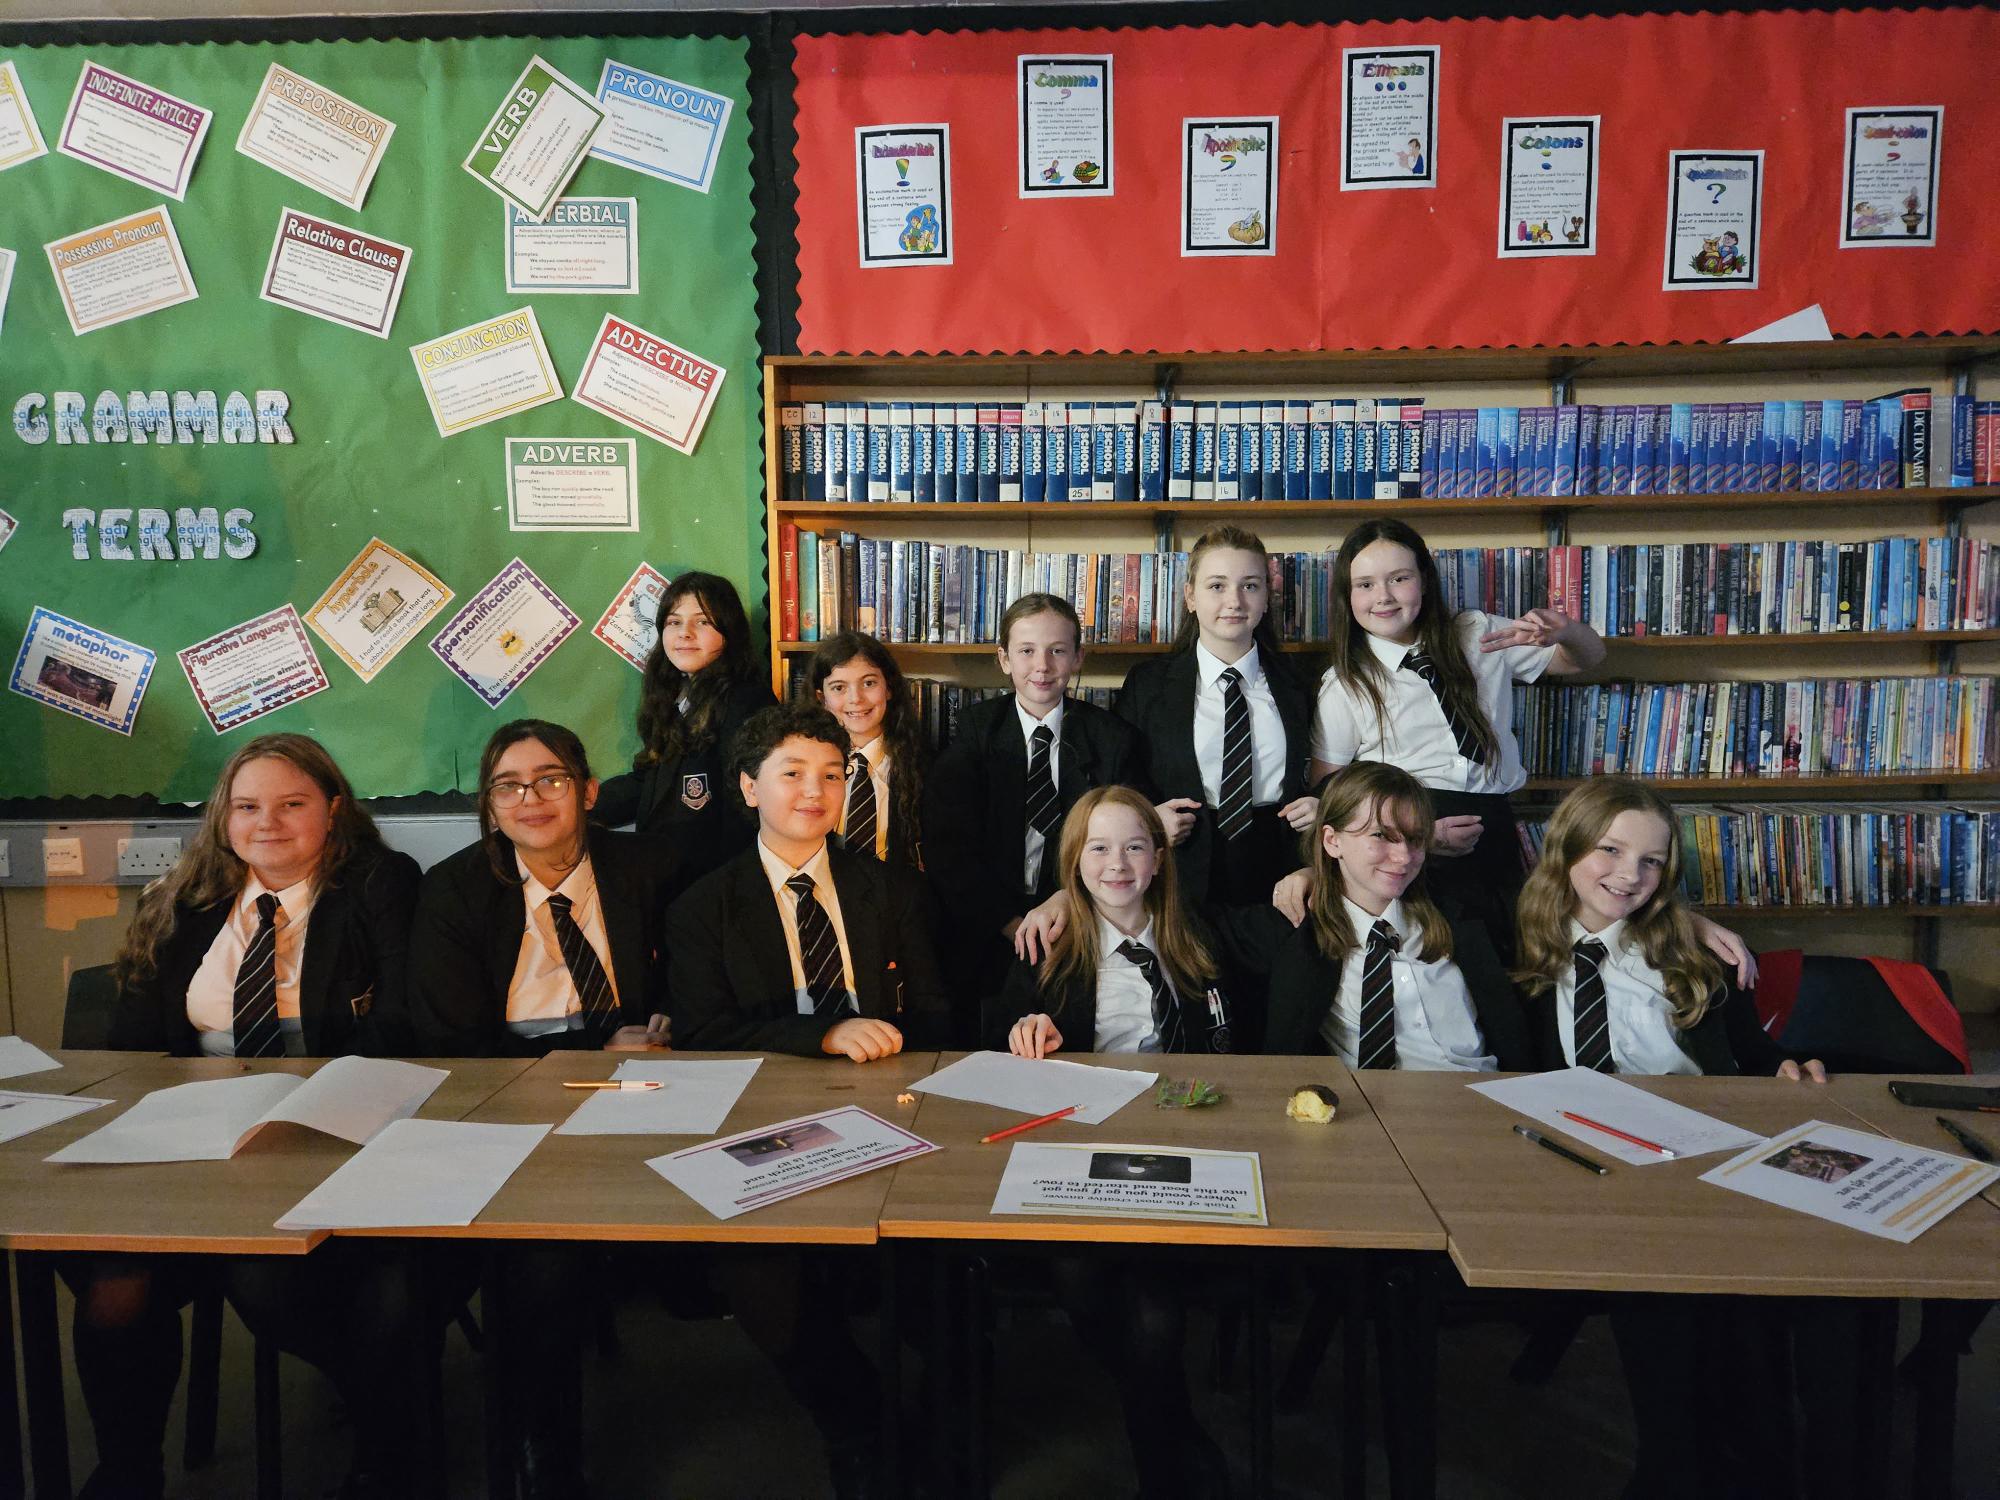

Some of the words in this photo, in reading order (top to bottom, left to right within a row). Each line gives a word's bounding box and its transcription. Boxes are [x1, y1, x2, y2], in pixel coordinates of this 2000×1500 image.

[86, 70, 153, 111] INDEFINITE
[149, 96, 199, 131] ARTICLE
[608, 67, 721, 120] PRONOUN
[1034, 72, 1098, 87] Comma
[270, 72, 382, 142] PREPOSITION
[484, 87, 538, 155] VERB
[1519, 134, 1583, 150] Colons
[514, 205, 625, 223] AERBIAL
[1705, 182, 1726, 204] ?
[54, 232, 114, 265] Possessive
[111, 215, 162, 246] Pronoun
[286, 216, 347, 252] Relative
[347, 236, 399, 269] Clause
[422, 317, 528, 367] CONJUNCTION
[605, 323, 712, 387] ADJECTIVE
[13, 390, 297, 444] GRAMMAR
[522, 445, 617, 462] ADVERB
[792, 431, 800, 473] SCHOOL
[814, 432, 822, 474] SCHOOL
[856, 432, 864, 474] SCHOOL
[878, 432, 886, 475] SCHOOL
[901, 432, 909, 475] SCHOOL
[923, 433, 931, 475] SCHOOL
[945, 433, 953, 475] SCHOOL
[966, 433, 974, 475] SCHOOL
[988, 433, 996, 474] SCHOOL
[1011, 433, 1019, 475] SCHOOL
[1033, 432, 1041, 475] SCHOOL
[1056, 432, 1064, 475] SCHOOL
[1081, 432, 1089, 475] SCHOOL
[1104, 432, 1113, 474] SCHOOL
[1125, 431, 1133, 474] SCHOOL
[1151, 431, 1160, 473] SCHOOL
[1182, 431, 1190, 473] SCHOOL
[1203, 431, 1212, 473] SCHOOL
[1220, 432, 1228, 474] DICTIONARY
[1228, 432, 1236, 474] SCHOOL
[1251, 431, 1259, 473] SCHOOL
[1272, 431, 1280, 473] SCHOOL
[1297, 431, 1305, 473] SCHOOL
[1321, 431, 1329, 472] SCHOOL
[1344, 430, 1352, 472] SCHOOL
[1357, 430, 1365, 472] DICTIONARY
[1365, 430, 1374, 472] SCHOOL
[1381, 430, 1389, 472] DICTIONARY
[1389, 430, 1398, 472] SCHOOL
[1403, 430, 1411, 472] DICTIONARY
[1410, 429, 1420, 472] SCHOOL
[1913, 412, 1925, 480] DICTIONARY
[1976, 418, 1986, 467] ENGLISH
[1072, 489, 1082, 498] 25
[62, 507, 256, 560] TERMS
[327, 560, 379, 617] hyperbole
[362, 644, 375, 657] had
[372, 637, 381, 646] to
[378, 625, 394, 640] read
[394, 608, 410, 623] book
[407, 597, 421, 610] that
[419, 588, 431, 599] was
[443, 572, 525, 655] personification
[609, 620, 624, 633] Zany
[50, 623, 130, 667] metaphor
[188, 637, 241, 669] Figurative
[238, 615, 291, 648] Language
[368, 646, 386, 664] about
[405, 610, 423, 628] pages
[275, 657, 307, 676] simile
[488, 680, 500, 692] The
[497, 671, 509, 683] hot
[507, 662, 519, 673] sun
[516, 645, 535, 664] smiled
[532, 631, 549, 648] down
[547, 625, 557, 634] on
[259, 673, 316, 704] personification
[773, 1160, 792, 1168] it?
[804, 1156, 830, 1165] this
[828, 1148, 857, 1158] built
[853, 1141, 881, 1150] Who
[741, 1174, 768, 1185] and
[765, 1163, 808, 1177] church
